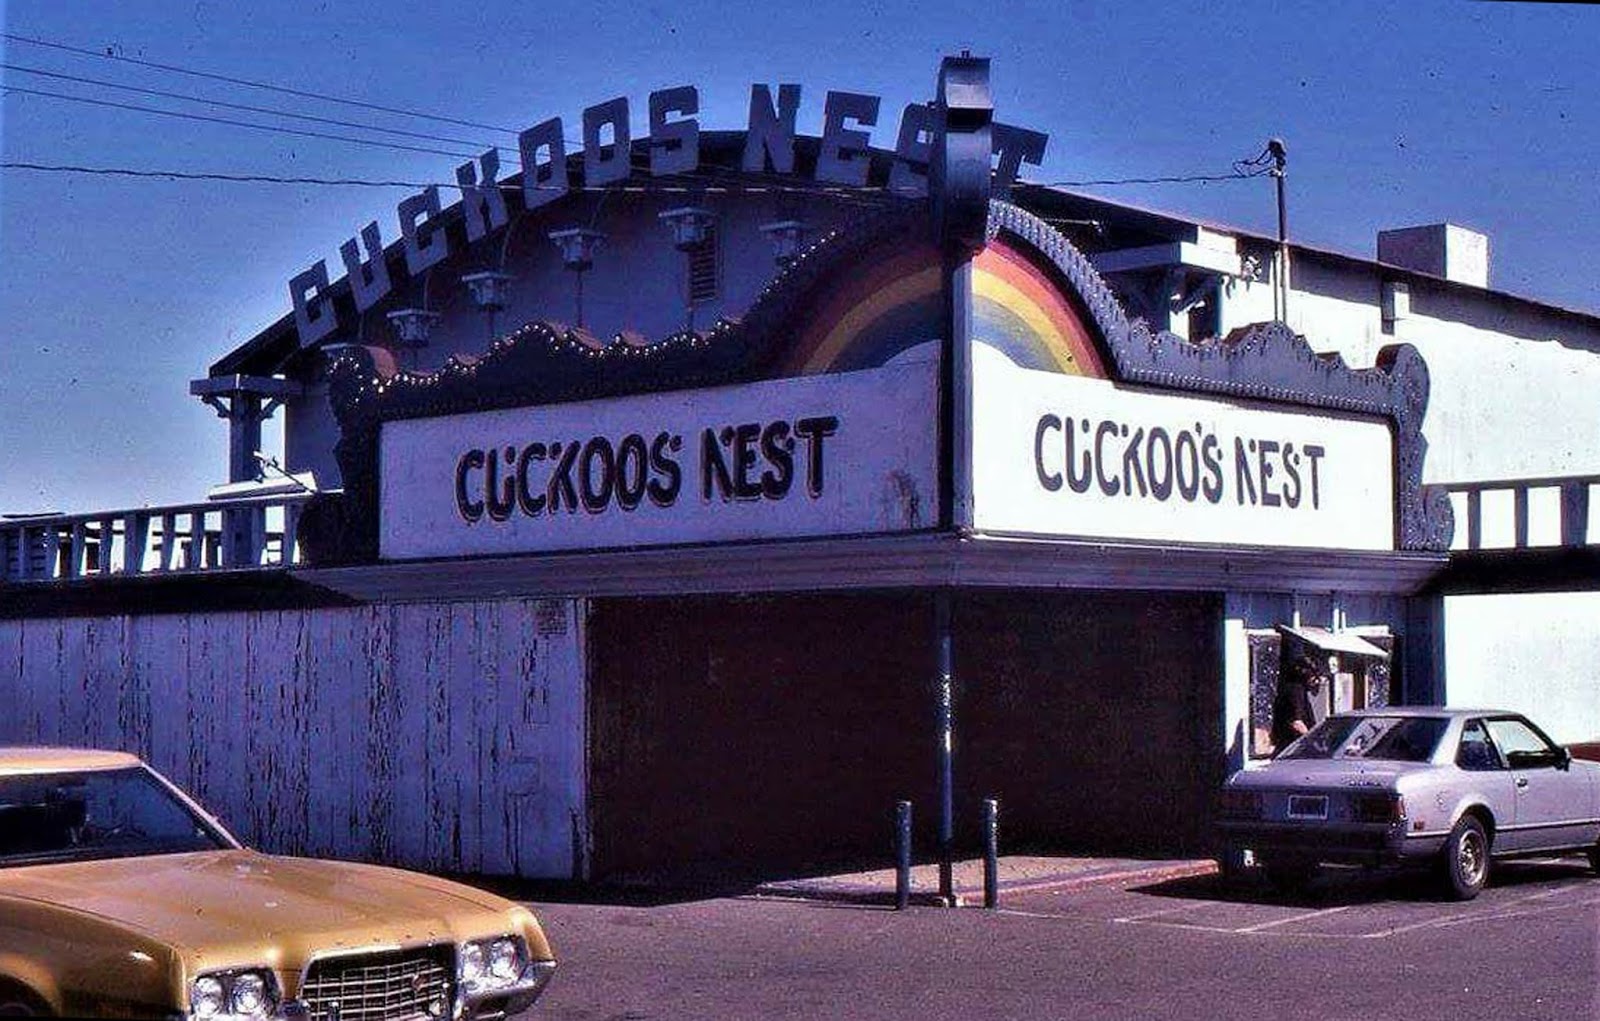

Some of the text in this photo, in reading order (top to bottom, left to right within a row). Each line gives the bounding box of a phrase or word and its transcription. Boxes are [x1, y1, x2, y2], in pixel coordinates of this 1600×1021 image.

[289, 84, 703, 349] CUCKOOS
[455, 415, 838, 524] CUCKOOS NEST
[1035, 413, 1325, 510] CUCKOO'S NEST
